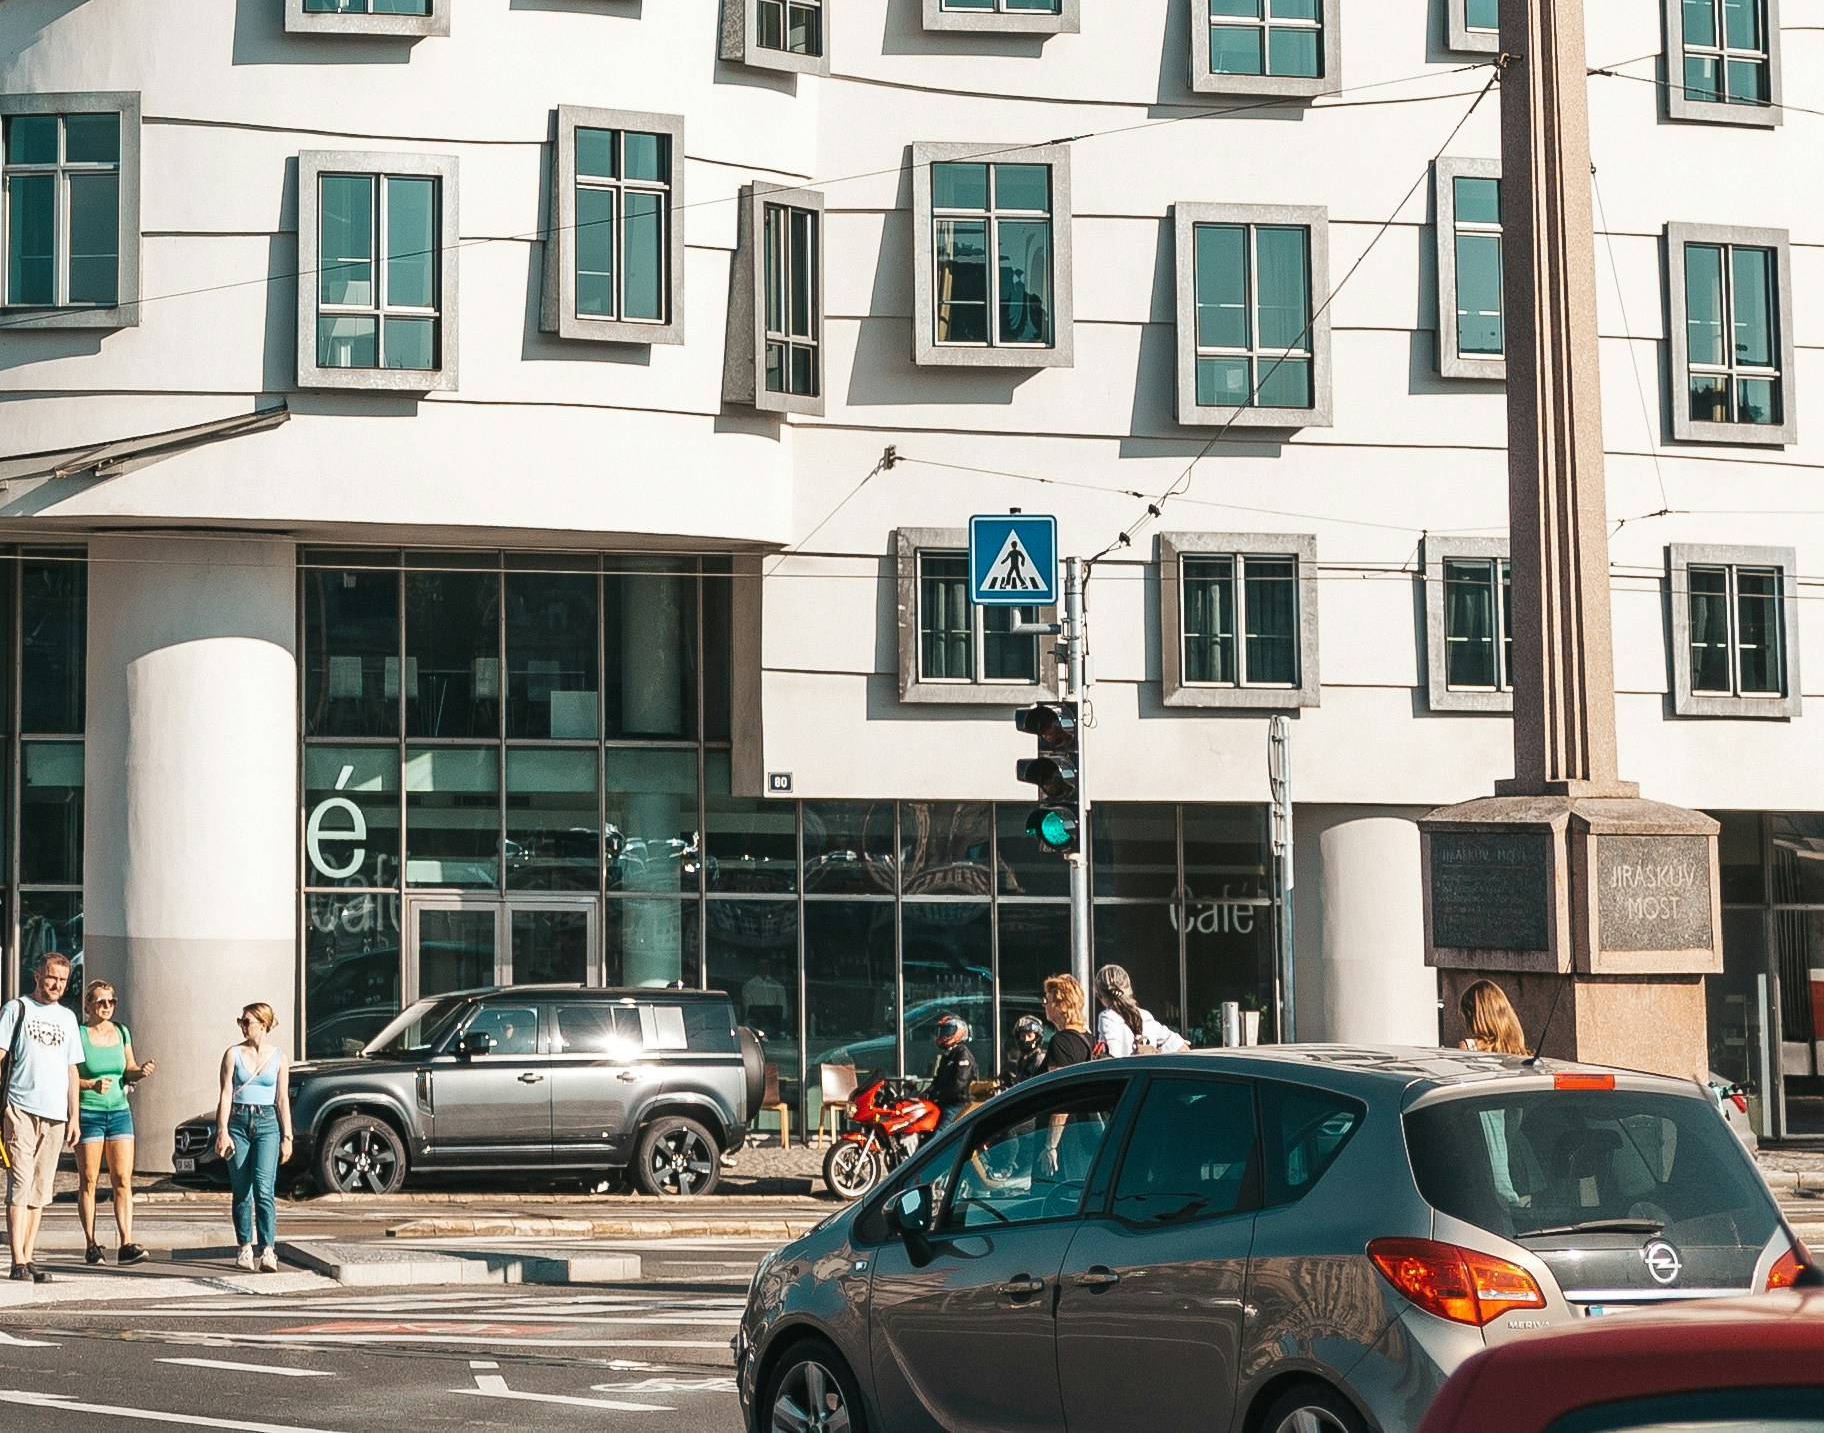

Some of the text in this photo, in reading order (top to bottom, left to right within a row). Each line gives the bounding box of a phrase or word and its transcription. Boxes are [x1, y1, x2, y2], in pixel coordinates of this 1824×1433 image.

[775, 776, 788, 788] 80
[1169, 882, 1255, 934] Café
[1627, 896, 1680, 920] MOST
[1507, 1321, 1550, 1330] MERIVA
